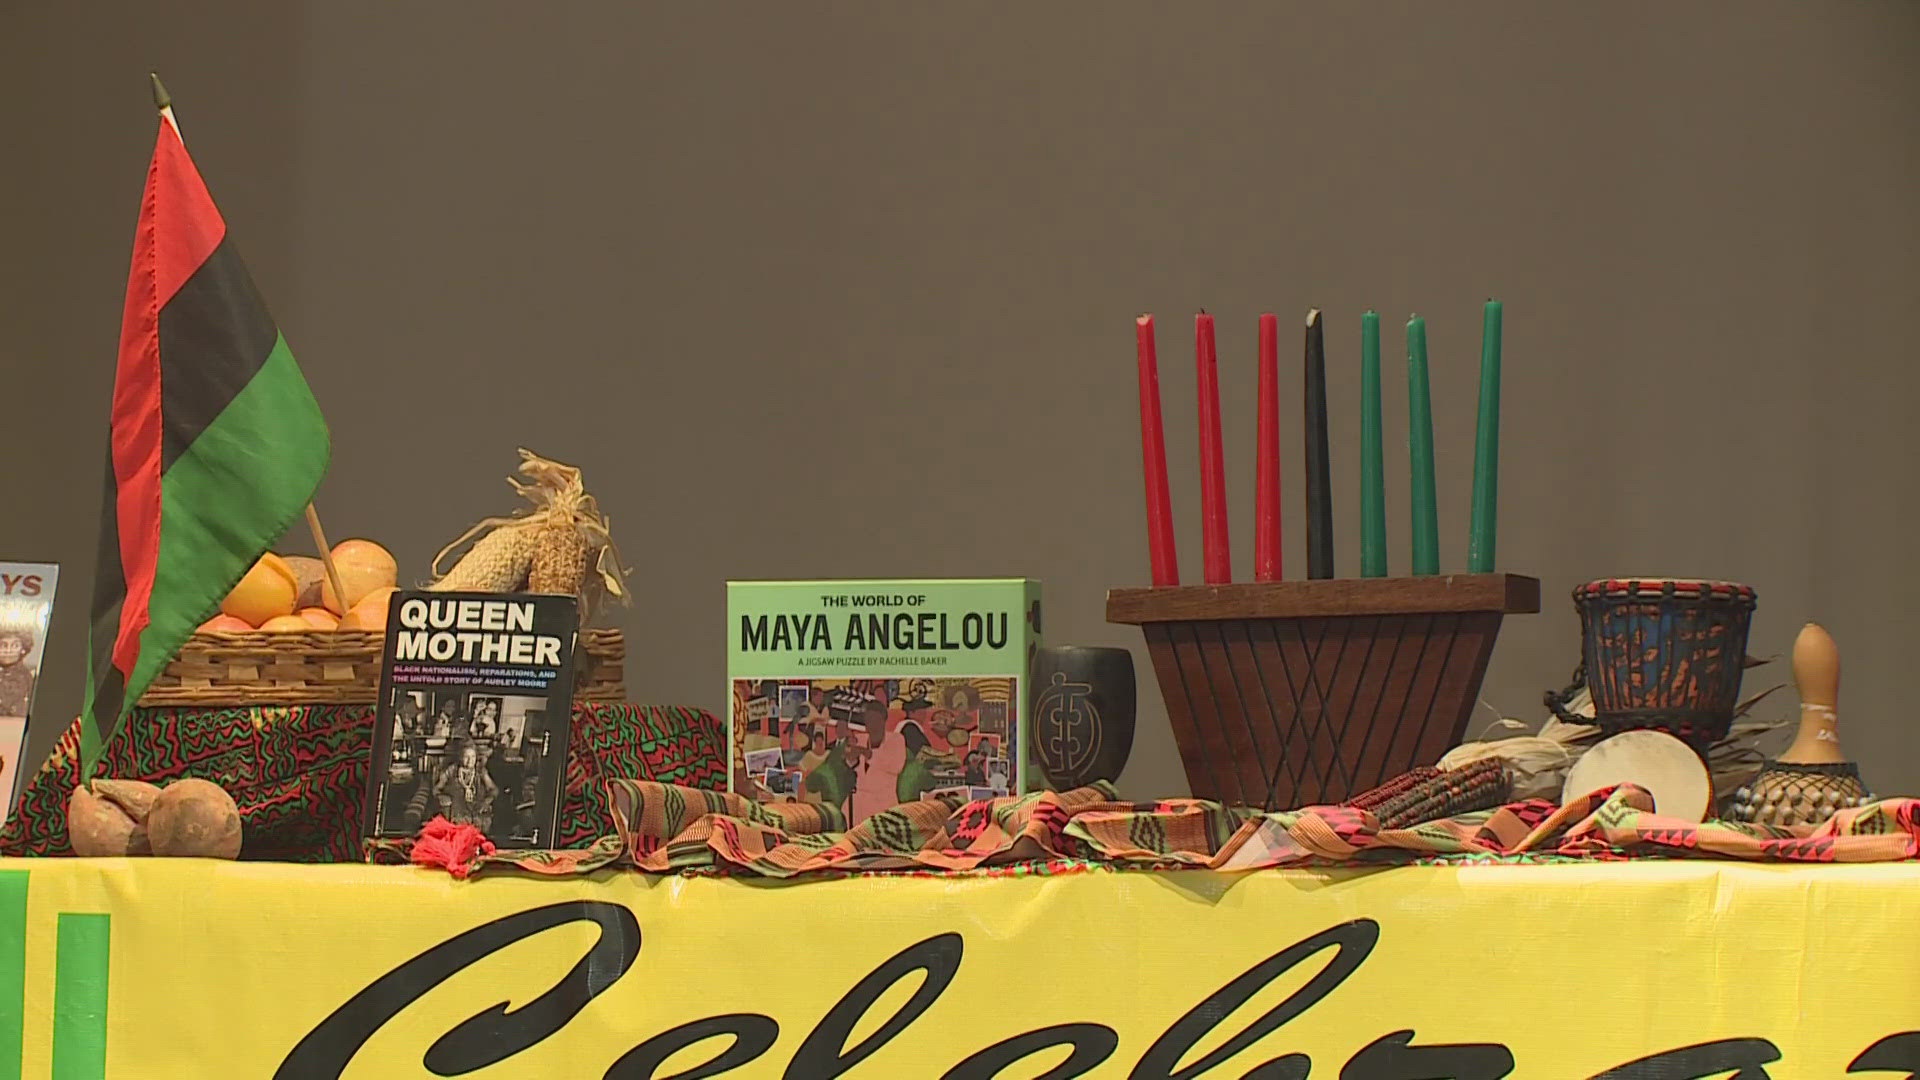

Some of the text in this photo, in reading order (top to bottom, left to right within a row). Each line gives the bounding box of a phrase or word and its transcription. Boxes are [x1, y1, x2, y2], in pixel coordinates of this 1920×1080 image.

[821, 595, 926, 607] THE WORLD OF
[400, 599, 535, 632] QUEEN
[741, 612, 1008, 652] MAYA ANGELOU
[395, 631, 561, 666] MOTHER
[798, 657, 948, 667] A JIGSAW PUZZLE BY RACHELLE BAKER
[421, 666, 478, 675] NATIONALISM,
[479, 668, 537, 677] REPARATIONS,
[484, 678, 516, 686] AUDLEY
